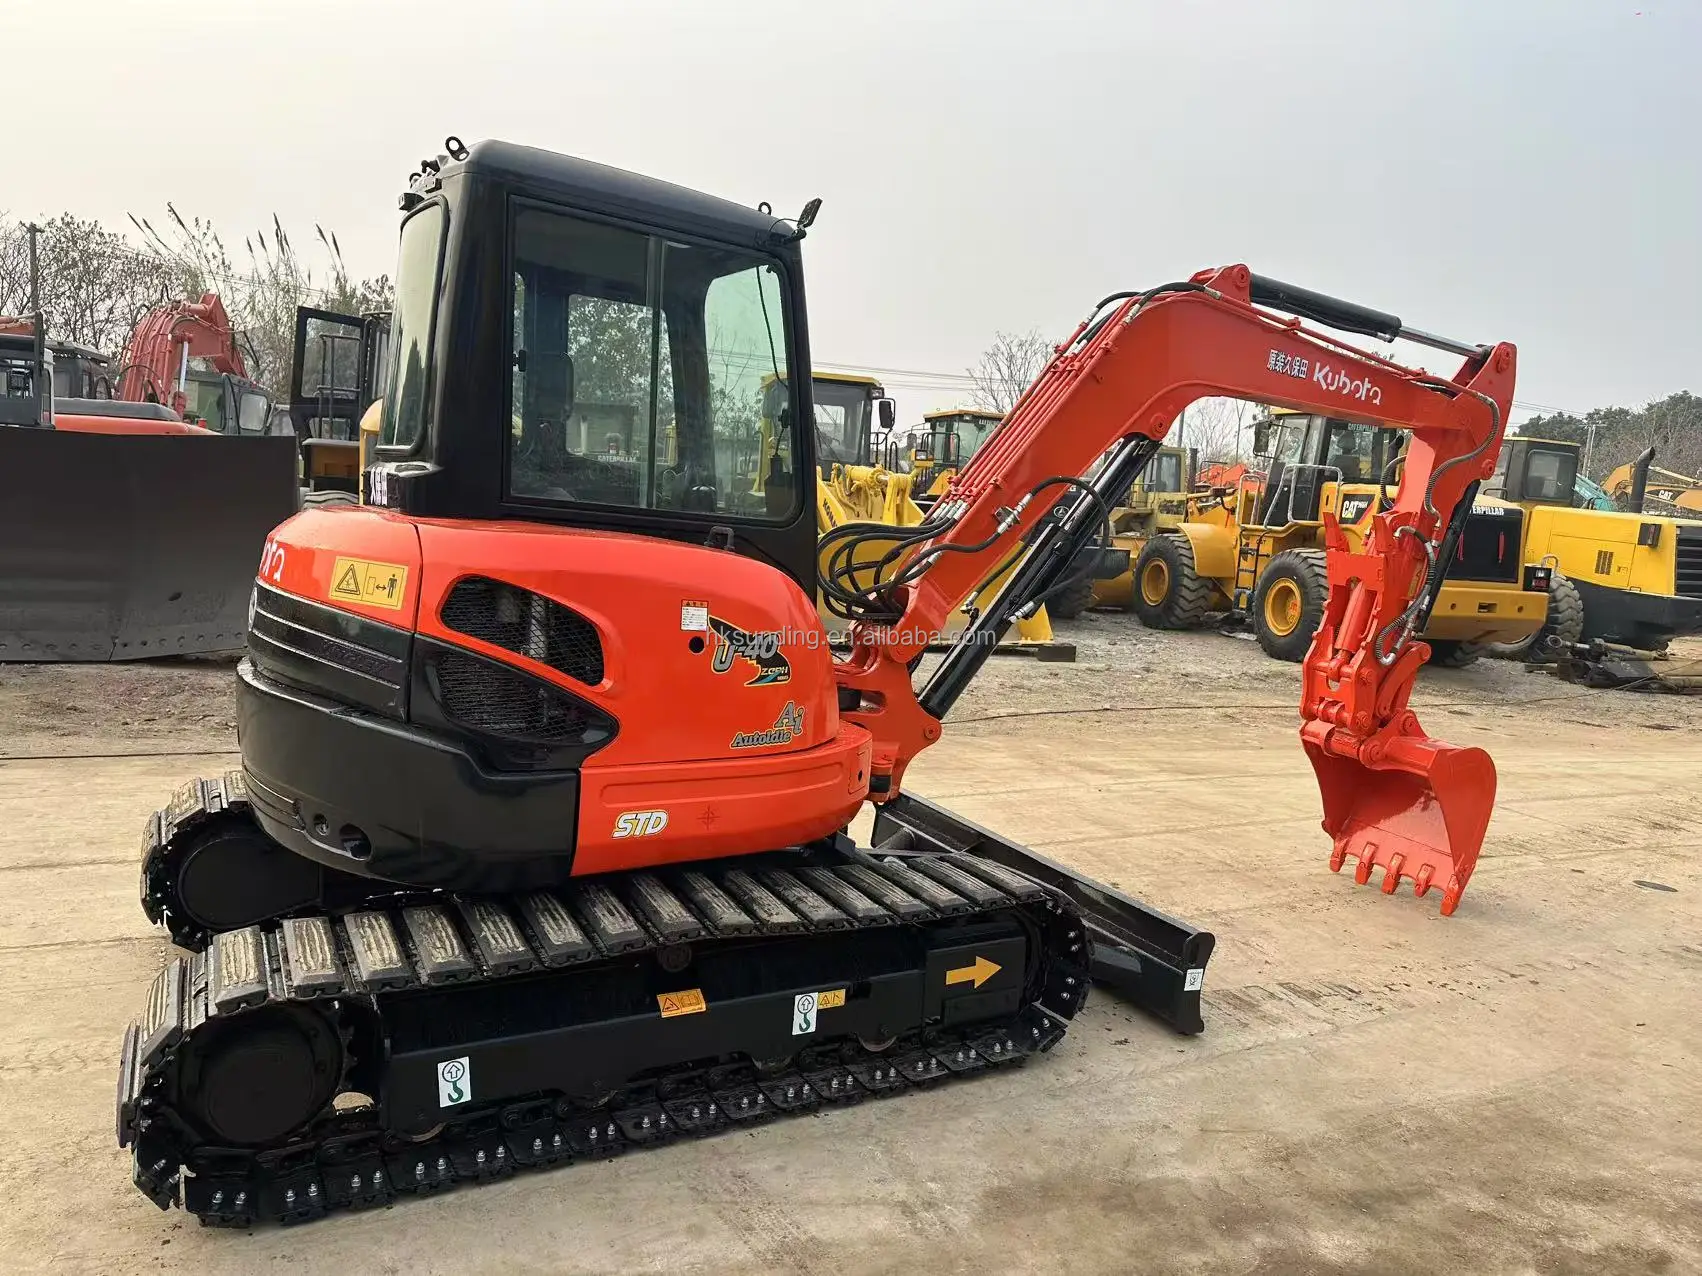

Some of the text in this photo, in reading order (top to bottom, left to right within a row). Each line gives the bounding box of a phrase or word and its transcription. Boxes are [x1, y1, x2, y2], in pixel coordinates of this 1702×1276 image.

[1267, 349, 1309, 379] 原装久保田
[1313, 362, 1382, 406] Kubota
[1342, 501, 1358, 518] CAT
[1658, 490, 1673, 500] CAT
[713, 632, 780, 672] U-40
[612, 810, 668, 839] STD
